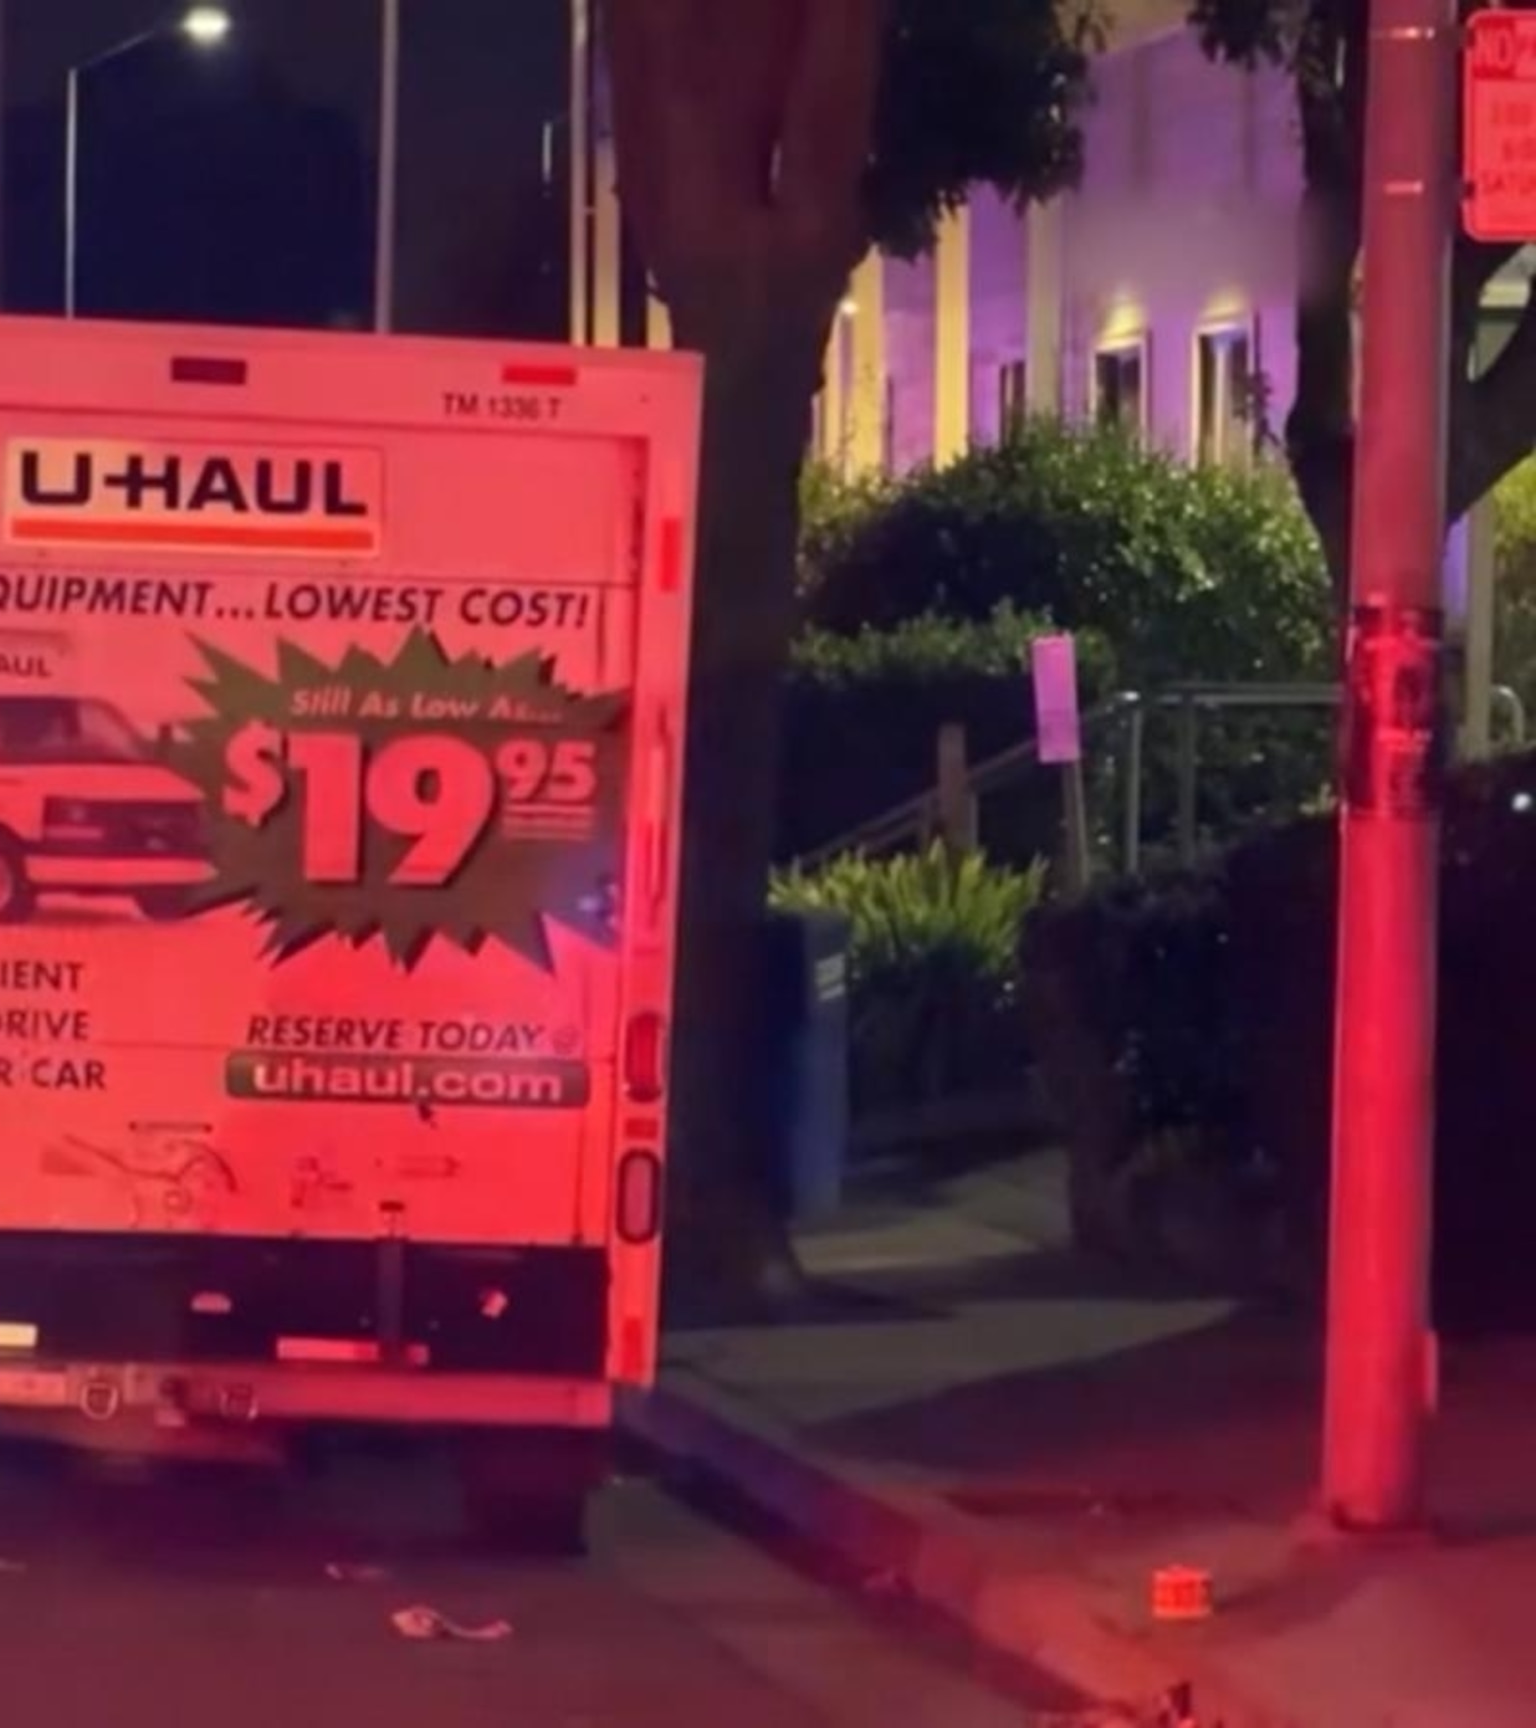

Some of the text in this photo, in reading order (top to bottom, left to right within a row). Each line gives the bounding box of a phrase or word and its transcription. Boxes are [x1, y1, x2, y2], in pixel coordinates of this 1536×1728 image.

[442, 392, 479, 417] TM
[21, 450, 368, 516] U-HAUL
[265, 582, 445, 625] LOWEST
[458, 588, 590, 629] COST!
[289, 688, 352, 717] Still
[357, 691, 400, 718] As
[410, 693, 480, 720] Low
[247, 1014, 404, 1049] RESERVE
[419, 1020, 543, 1052] TODAY
[29, 1059, 107, 1090] CAR
[253, 1057, 563, 1101] uhaul.com
